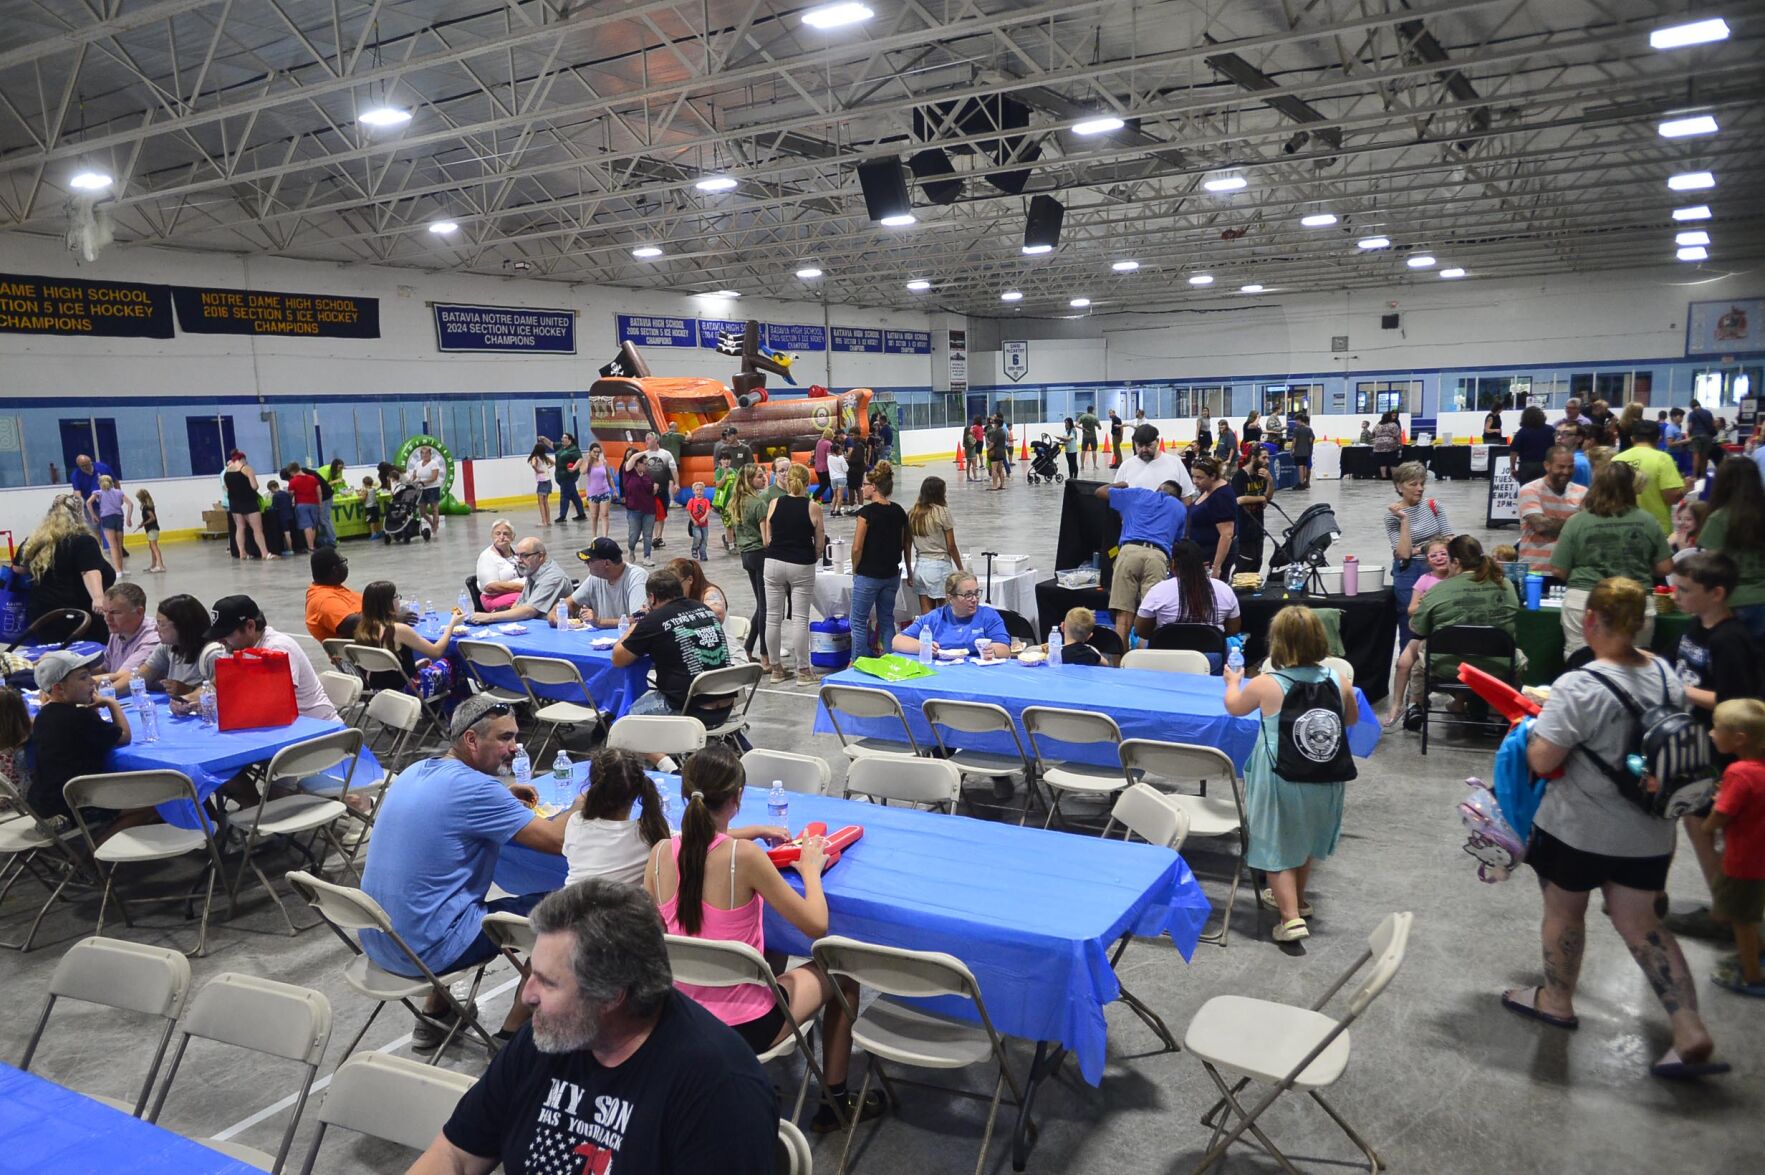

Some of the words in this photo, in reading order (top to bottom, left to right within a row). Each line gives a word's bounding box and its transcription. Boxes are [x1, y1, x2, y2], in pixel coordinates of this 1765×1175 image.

[43, 286, 83, 299] HIGH
[88, 288, 152, 304] SCHOOL
[201, 293, 244, 306] NOTRE
[249, 295, 280, 308] DAME
[285, 298, 311, 310] HIGH
[315, 299, 358, 312] SCHOOL
[44, 303, 53, 313] 5
[59, 303, 85, 315] ICE
[91, 304, 153, 318] HOCKEY
[203, 306, 228, 318] 2016
[233, 307, 282, 321] SECTION
[287, 309, 293, 321] 5
[297, 310, 313, 321] ICE
[317, 311, 359, 323] HOCKEY
[0, 315, 93, 331] CHAMPIONS
[441, 311, 480, 322] BATAVIA
[482, 313, 512, 324] NOTRE
[514, 315, 537, 326] DAME
[540, 317, 569, 327] UNITED
[629, 317, 652, 327] BATAVIA
[652, 318, 665, 328] HIGH
[665, 320, 685, 329] SCHOOL
[254, 321, 319, 334] CHAMPIONS
[446, 323, 467, 333] 2024
[469, 323, 508, 335] SECTION
[509, 325, 516, 334] V
[517, 326, 531, 335] ICE
[533, 326, 566, 337] HOCKEY
[640, 327, 660, 337] SECTION
[672, 329, 689, 338] HOCKEY
[701, 321, 725, 331] BATAVIA
[725, 323, 740, 333] HIGH
[770, 325, 790, 335] BATAVIA
[790, 326, 804, 335] HIGH
[804, 327, 823, 336] SCHOOL
[833, 328, 852, 337] BATAVIA
[864, 330, 880, 339] SCHOOL
[484, 334, 535, 346] CHAMPIONS
[1012, 353, 1019, 366] 6
[662, 621, 672, 631] 25
[671, 614, 690, 626] YEARS
[543, 1077, 586, 1116] MY
[594, 1096, 634, 1134] SON
